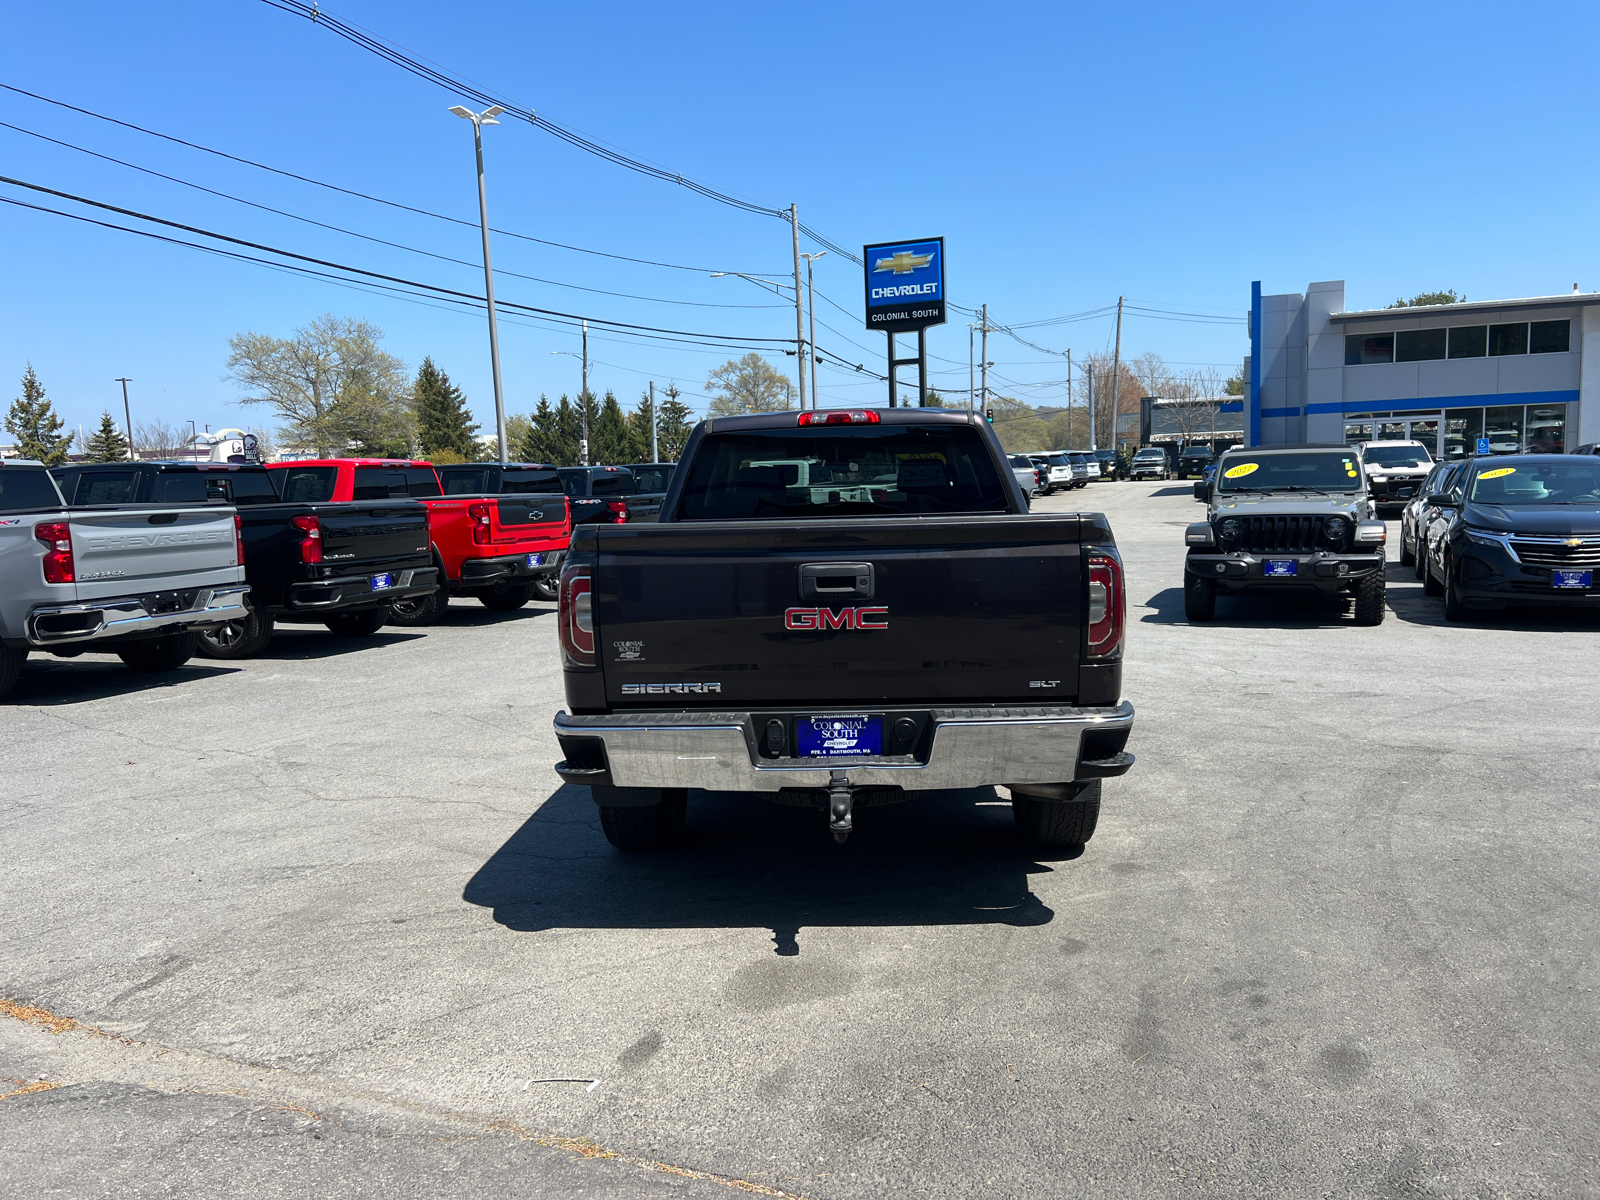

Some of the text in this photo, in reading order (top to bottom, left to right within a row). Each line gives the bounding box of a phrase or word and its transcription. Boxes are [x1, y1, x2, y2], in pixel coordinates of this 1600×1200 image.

[871, 282, 938, 299] CHEVROLET
[871, 308, 939, 322] COLONIAL SOUTH
[1231, 464, 1253, 477] 2022
[88, 530, 231, 550] CHEVROLET
[785, 606, 889, 630] GMC
[621, 682, 722, 695] SIERRA
[1028, 680, 1061, 688] SLT
[813, 721, 866, 730] COLONIAL
[821, 729, 858, 738] SOUTH
